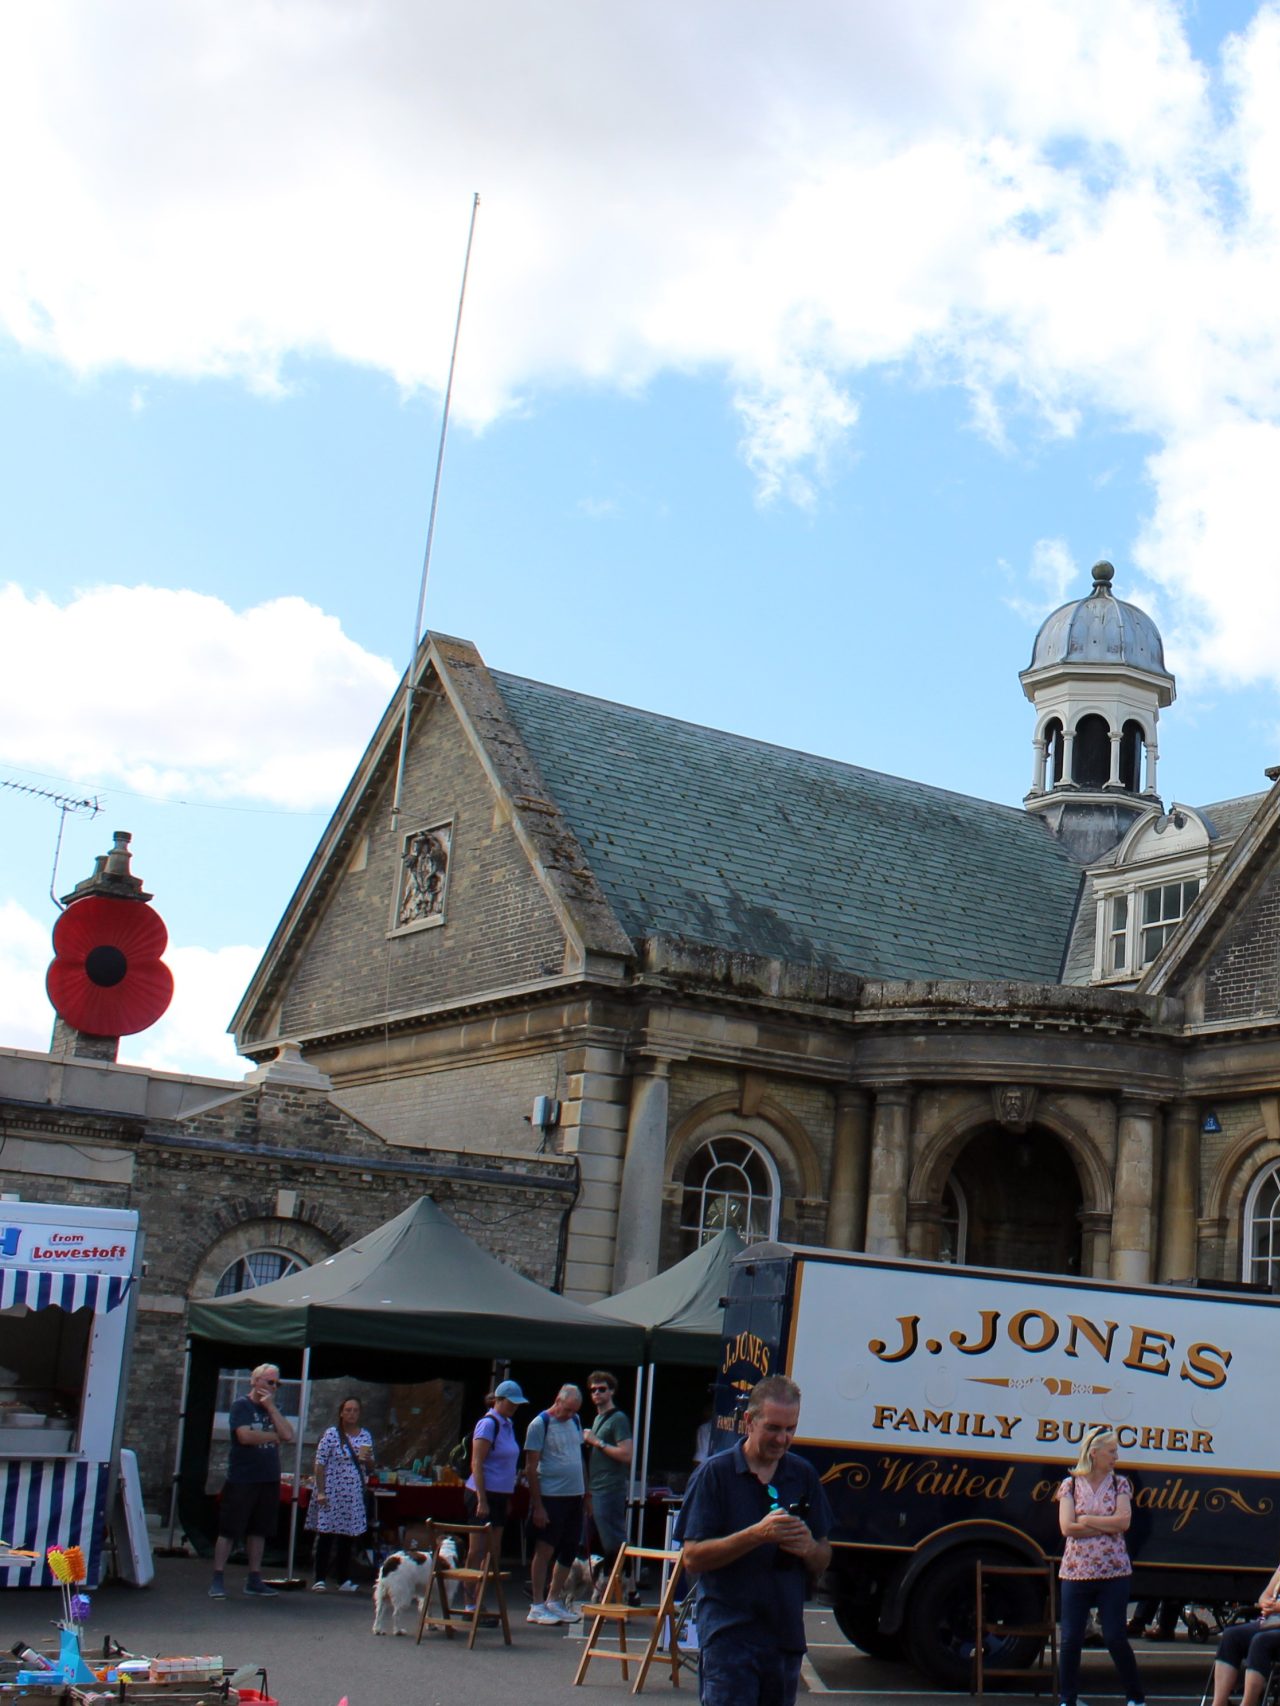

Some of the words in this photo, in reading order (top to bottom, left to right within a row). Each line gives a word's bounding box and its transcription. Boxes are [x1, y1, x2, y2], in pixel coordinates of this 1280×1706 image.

[33, 1245, 127, 1259] Lowestoft
[52, 1233, 84, 1242] from
[868, 1308, 1232, 1390] J.JONES
[871, 1404, 1022, 1438] FAMILY
[878, 1456, 1016, 1500] Waited
[1135, 1478, 1200, 1532] aily
